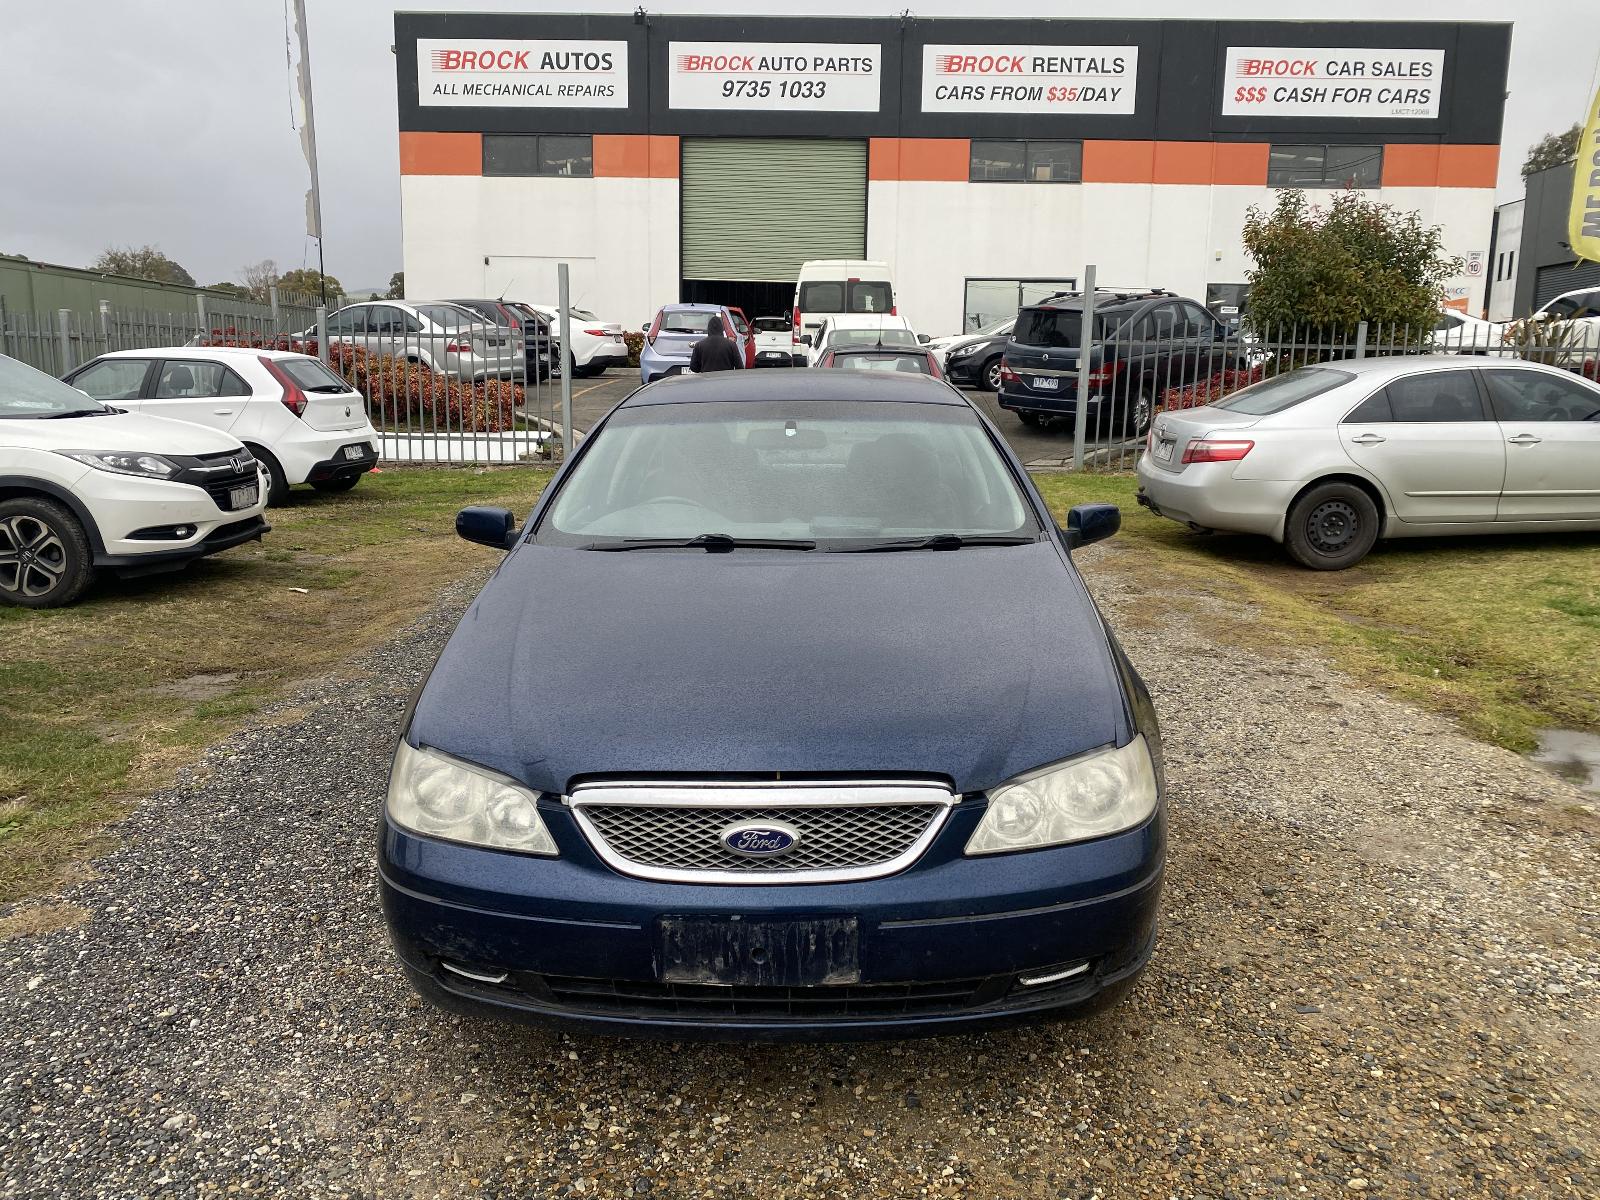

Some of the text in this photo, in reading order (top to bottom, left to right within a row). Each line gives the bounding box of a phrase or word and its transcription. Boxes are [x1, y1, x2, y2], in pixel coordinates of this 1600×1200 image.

[443, 50, 613, 71] BROCK AUTOS
[685, 55, 873, 73] BROCK AUTO PARTS
[946, 55, 1125, 74] BROCK RENTALS
[1245, 59, 1433, 77] BROCK CAR SALES
[433, 83, 615, 97] ALL MECHANICAL REPAIRS
[722, 80, 827, 99] 9735 1033
[935, 85, 1122, 103] CARS FROM $35/DAY
[1234, 86, 1431, 104] $$$ CASH FOR CARS
[1470, 264, 1479, 272] 10
[737, 830, 781, 849] Ford
